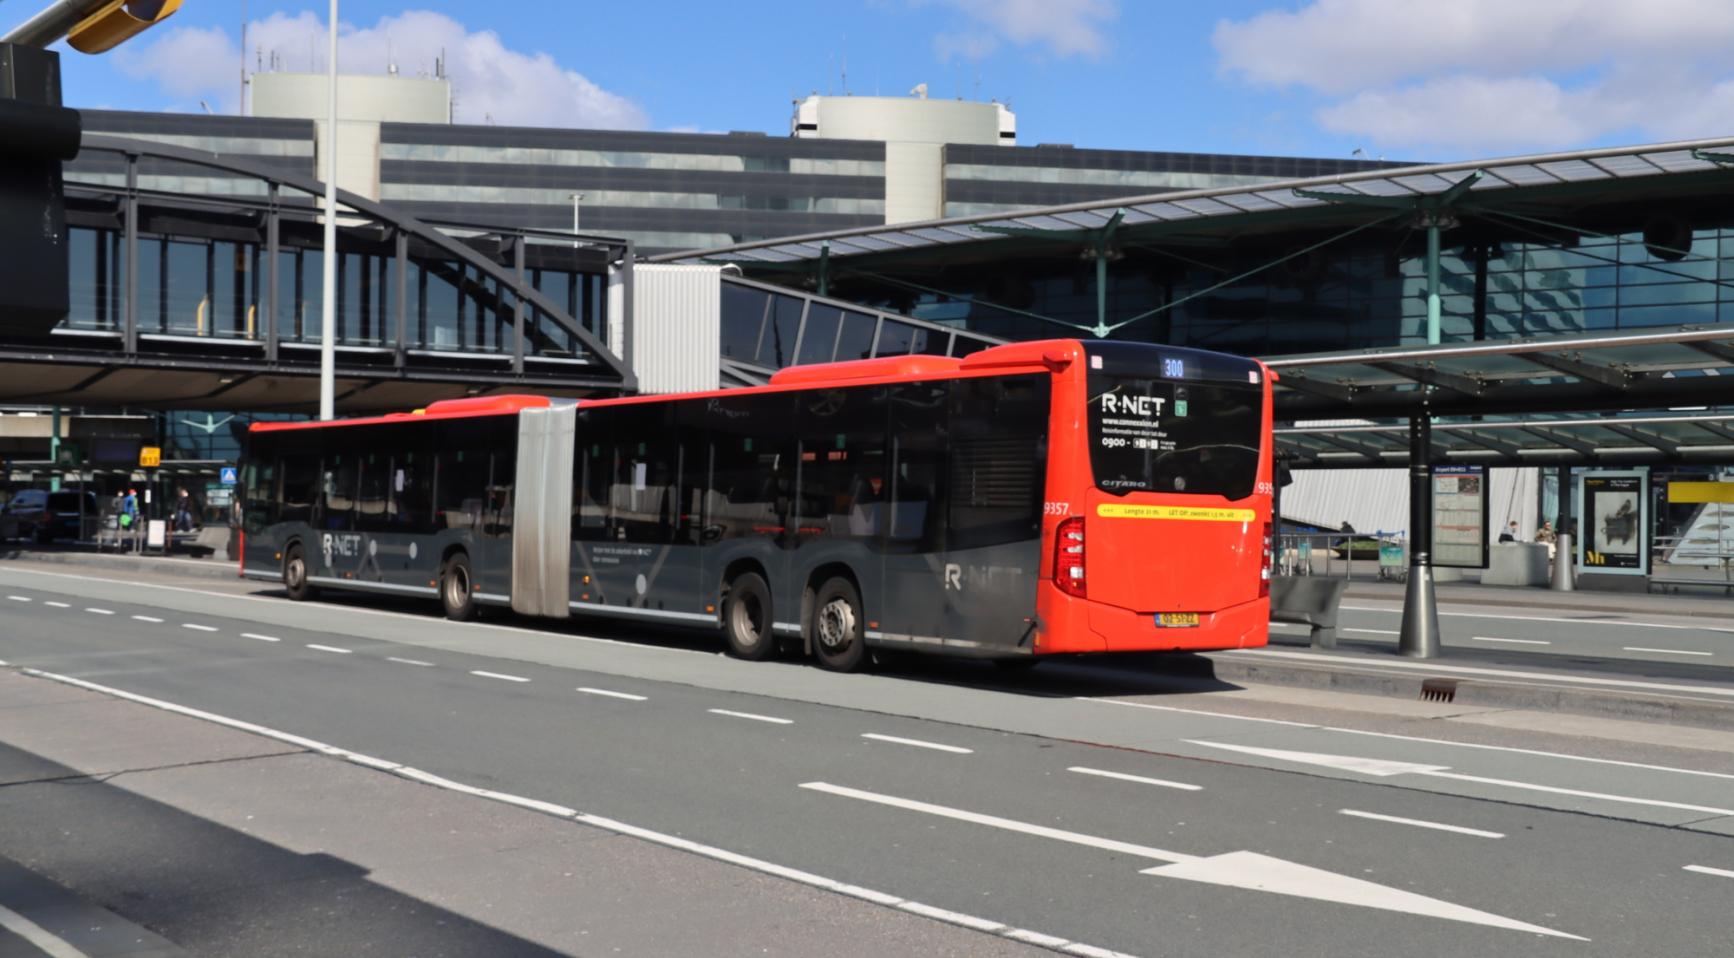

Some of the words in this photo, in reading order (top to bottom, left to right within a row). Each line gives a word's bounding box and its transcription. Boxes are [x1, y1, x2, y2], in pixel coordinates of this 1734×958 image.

[1165, 359, 1184, 377] 300
[1102, 437, 1125, 448] 0900
[1102, 480, 1146, 488] CITARO
[1044, 502, 1069, 515] 9357
[1124, 508, 1145, 516] Lengte
[1168, 508, 1178, 516] LET
